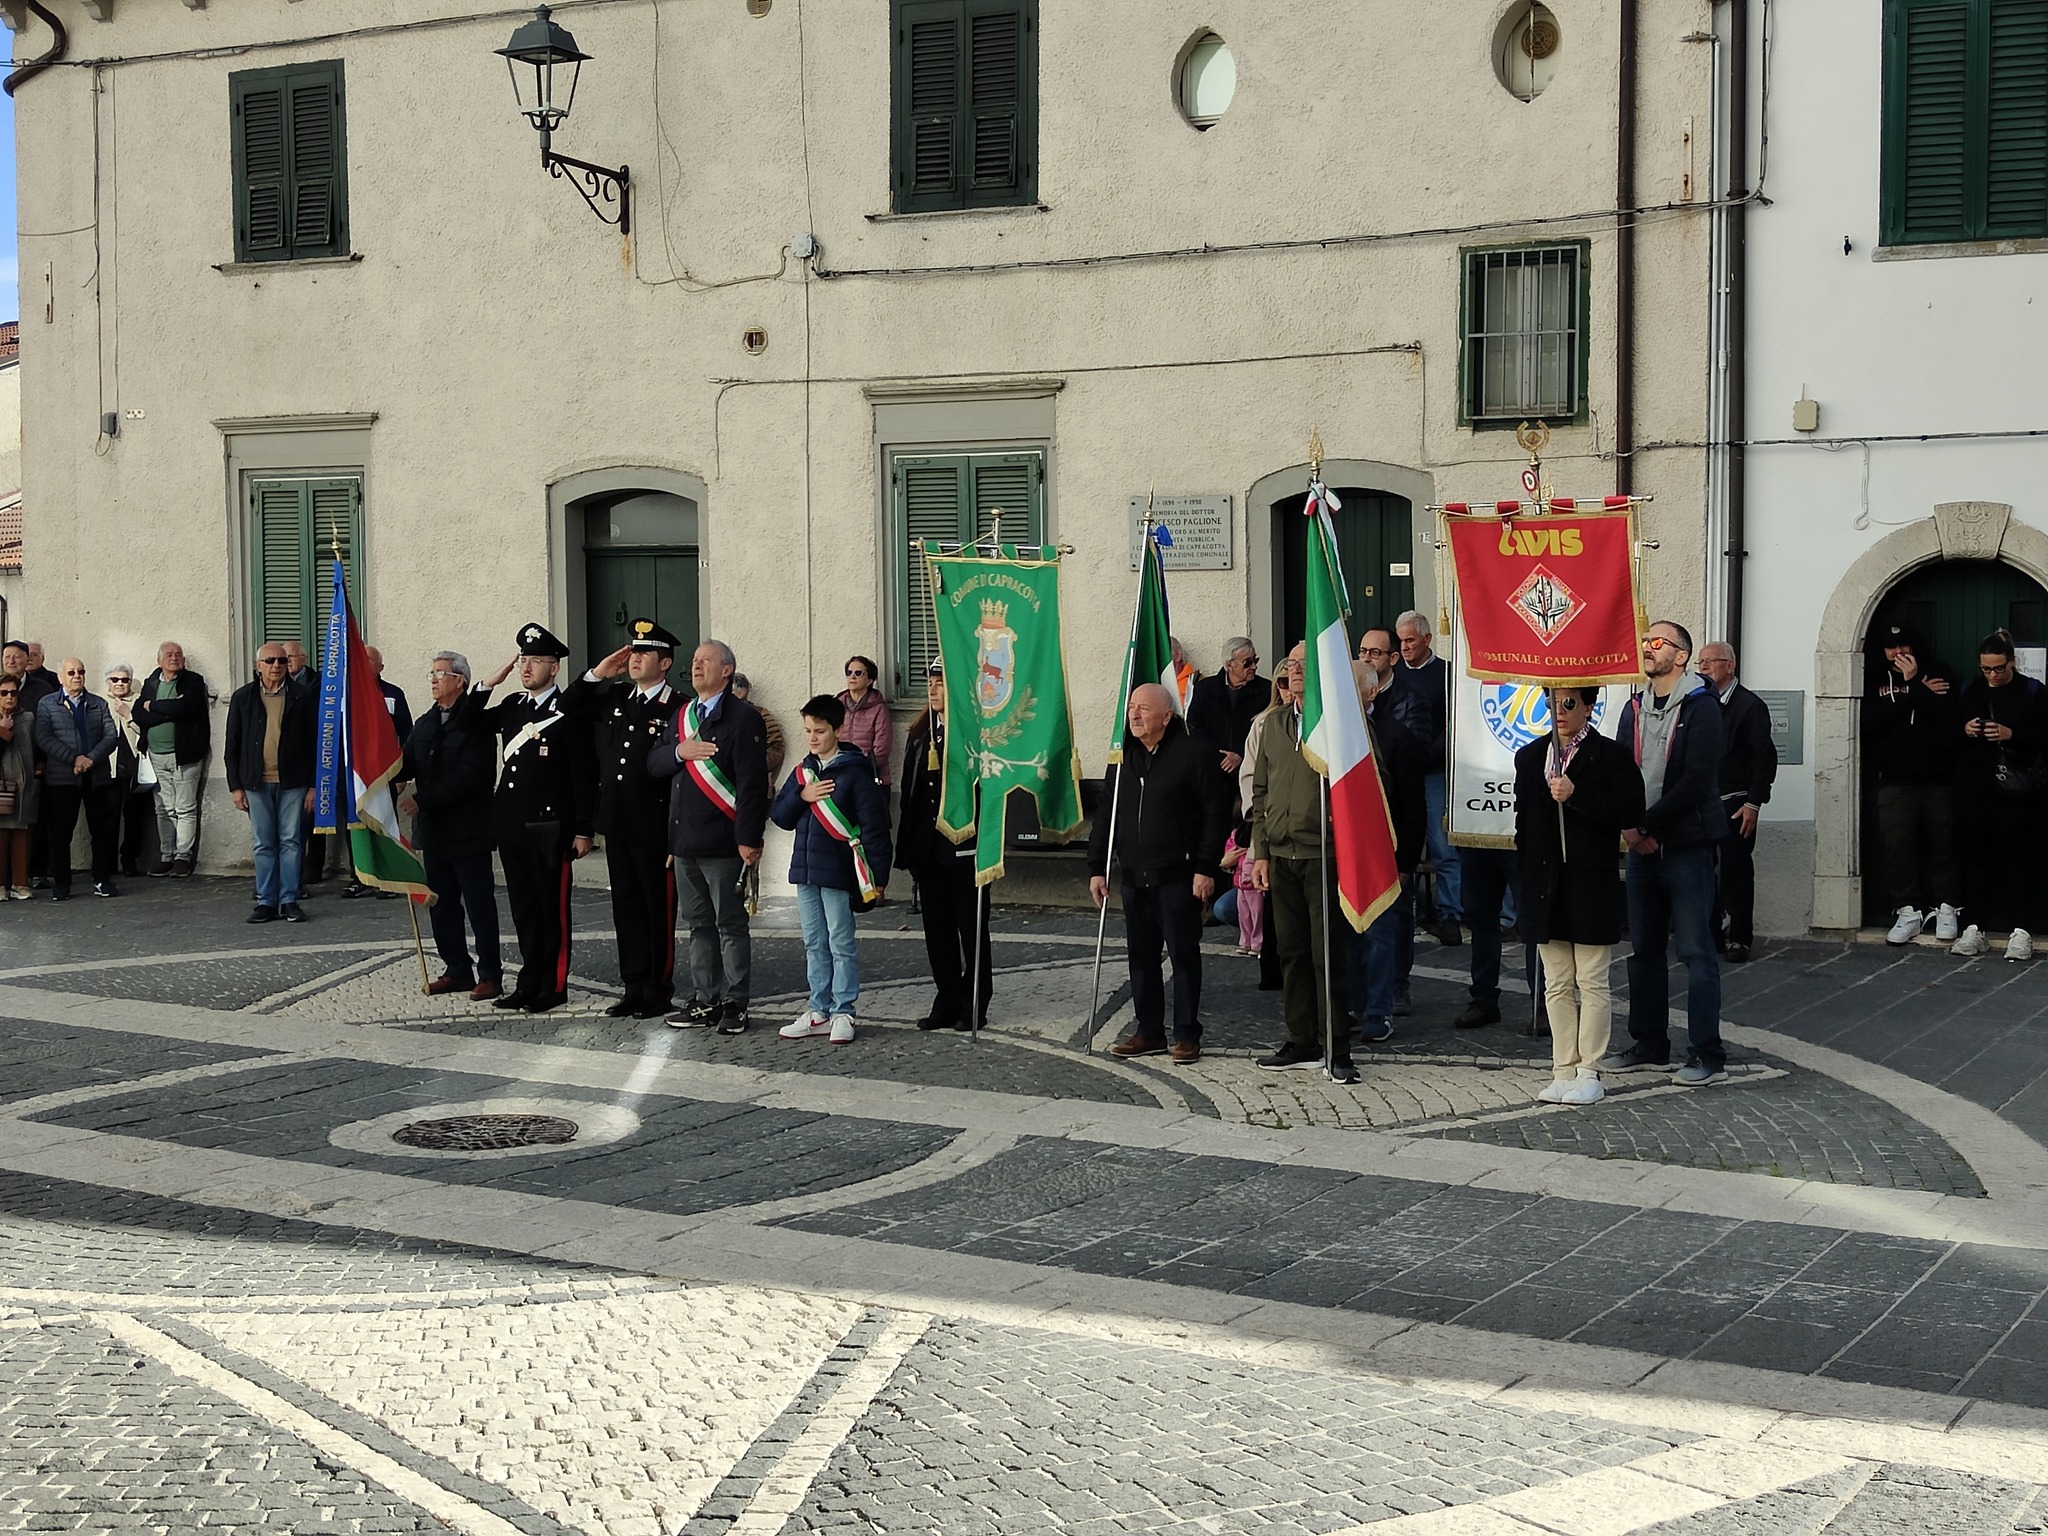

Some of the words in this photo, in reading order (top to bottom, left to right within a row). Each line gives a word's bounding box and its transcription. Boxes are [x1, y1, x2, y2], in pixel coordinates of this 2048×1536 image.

[1136, 518, 1181, 527] FRNCESCO
[1183, 517, 1222, 526] PAGLIONE
[1498, 528, 1584, 557] AVIS
[987, 573, 1041, 613] CAPRACOTTA
[327, 613, 341, 678] CAPRACOTTA
[1544, 652, 1629, 667] CAPRACOTTA
[326, 684, 337, 692] S
[325, 696, 336, 705] M
[325, 710, 335, 719] DI
[322, 722, 334, 770] ARTIGIANI
[320, 775, 330, 816] SOCIETA
